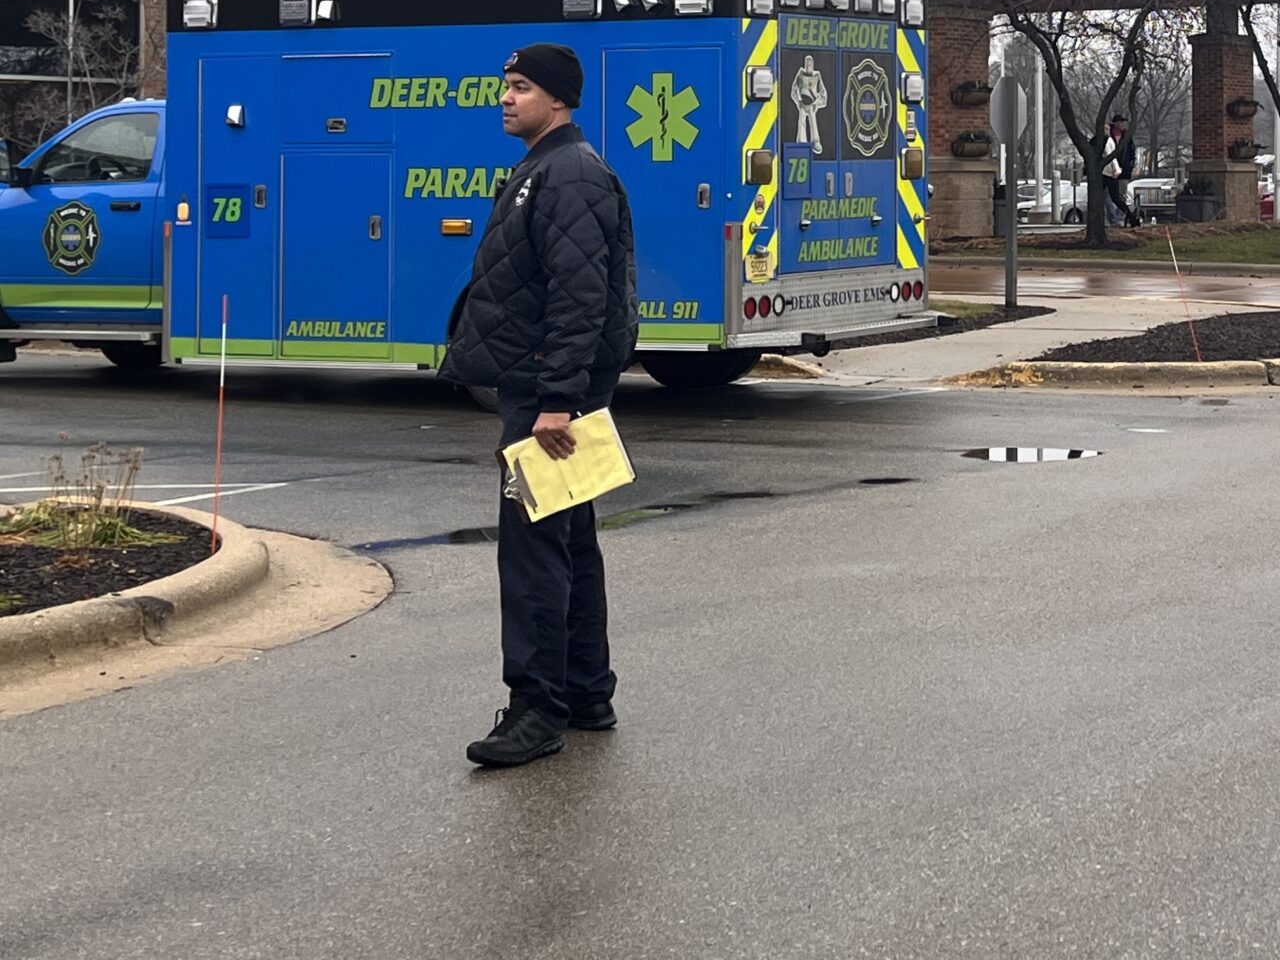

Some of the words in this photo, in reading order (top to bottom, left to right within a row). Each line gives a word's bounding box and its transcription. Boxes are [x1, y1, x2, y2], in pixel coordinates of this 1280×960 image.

[785, 17, 889, 50] DEER-GROVE
[369, 76, 507, 108] DEER-GR
[788, 158, 809, 183] 78
[212, 198, 242, 222] 78
[802, 197, 878, 220] PARAMEDIC
[798, 237, 878, 262] AMBULANCE
[638, 301, 667, 319] ALL
[672, 301, 699, 319] 911
[791, 297, 820, 311] DEER
[822, 291, 861, 307] GROVE
[863, 287, 886, 300] EMS
[286, 321, 386, 337] AMBULANCE
